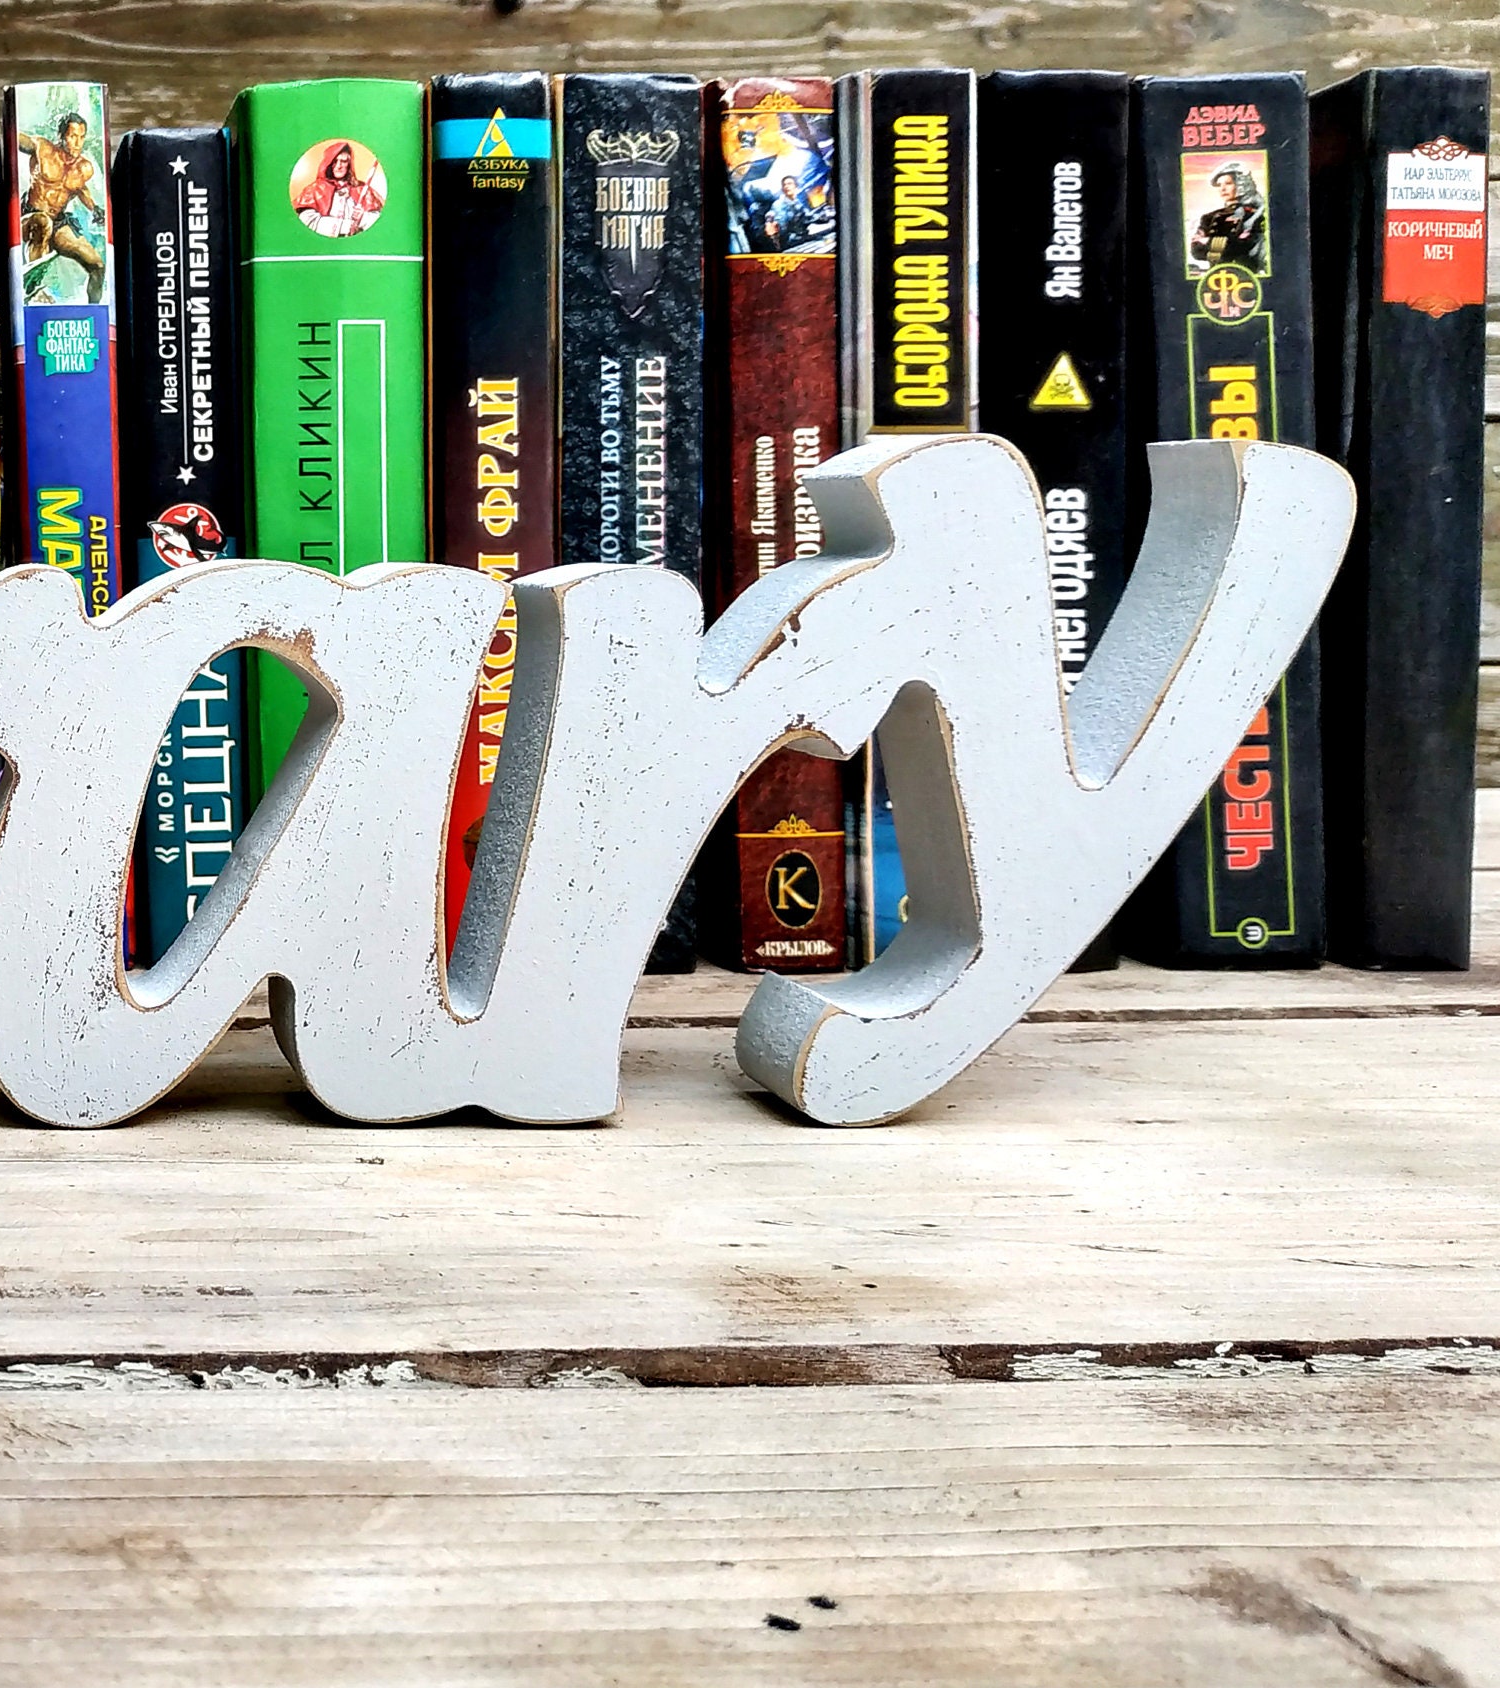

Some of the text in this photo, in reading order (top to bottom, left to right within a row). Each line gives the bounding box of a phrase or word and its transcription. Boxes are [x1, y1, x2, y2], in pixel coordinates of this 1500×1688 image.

[1184, 104, 1261, 124] ДЭВИД
[1182, 123, 1267, 147] ВЕБЕР
[467, 159, 530, 170] АЗБУКА
[472, 175, 526, 191] fantasy
[595, 177, 670, 212] БОЕВАЯ
[1391, 186, 1482, 202] ТАТЬЯНА МОРОЗОВА
[600, 214, 667, 260] МАГИЯ
[1045, 161, 1083, 299] Ян Валетов
[1388, 219, 1483, 239] КОРИЧНЕВЫЙ
[893, 114, 950, 408] ОБОРОНА ТУПИКА
[1423, 244, 1454, 260] МЕЧ
[46, 320, 91, 337] БОЕВАЯ
[156, 231, 179, 413] Иван СТРЕЛЬЦОВ
[187, 181, 214, 462] СЕКРЕТНЫЙ ПЕЛЕНГ
[54, 354, 86, 371] ТИКА
[599, 355, 621, 424] ТЬМУ
[298, 322, 334, 512] КЛИКИН
[468, 376, 520, 538] ФРАЙ
[600, 428, 621, 464] ВО
[751, 436, 776, 536] Якименко
